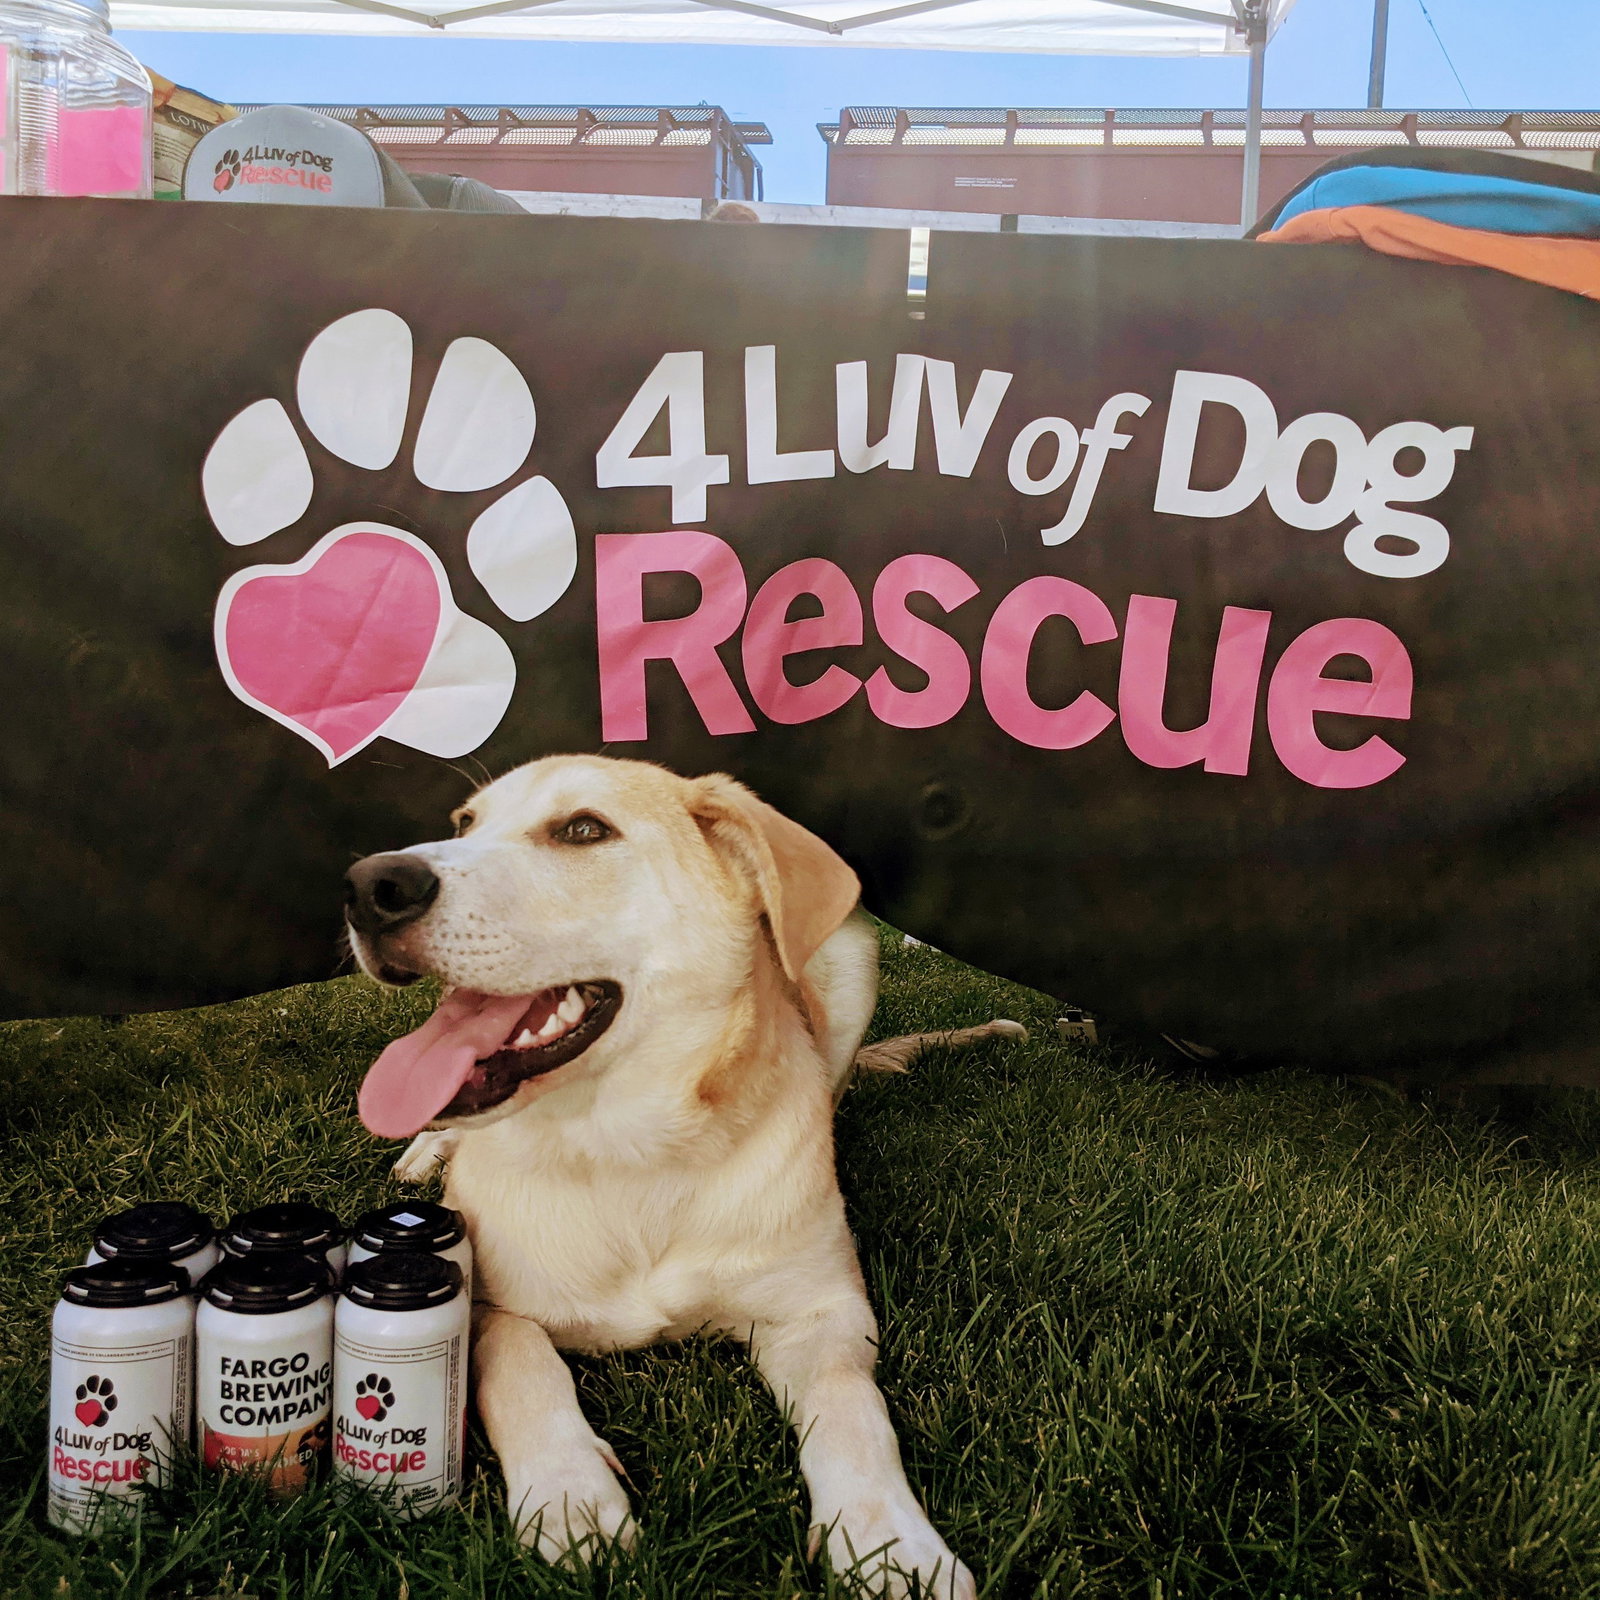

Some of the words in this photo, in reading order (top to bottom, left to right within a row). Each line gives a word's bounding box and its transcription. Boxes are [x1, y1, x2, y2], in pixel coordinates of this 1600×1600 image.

[285, 151, 301, 167] of
[302, 150, 333, 172] Dog
[240, 164, 333, 193] Rescue
[1008, 392, 1152, 547] of
[1153, 369, 1475, 579] Dog
[594, 530, 1414, 790] Rescue
[220, 1352, 310, 1379] FARGO
[220, 1362, 330, 1402] BREWING
[94, 1437, 112, 1457] of
[113, 1432, 152, 1451] Dog
[335, 1432, 427, 1473] Rescue
[373, 1431, 389, 1449] of
[391, 1427, 427, 1446] Dog
